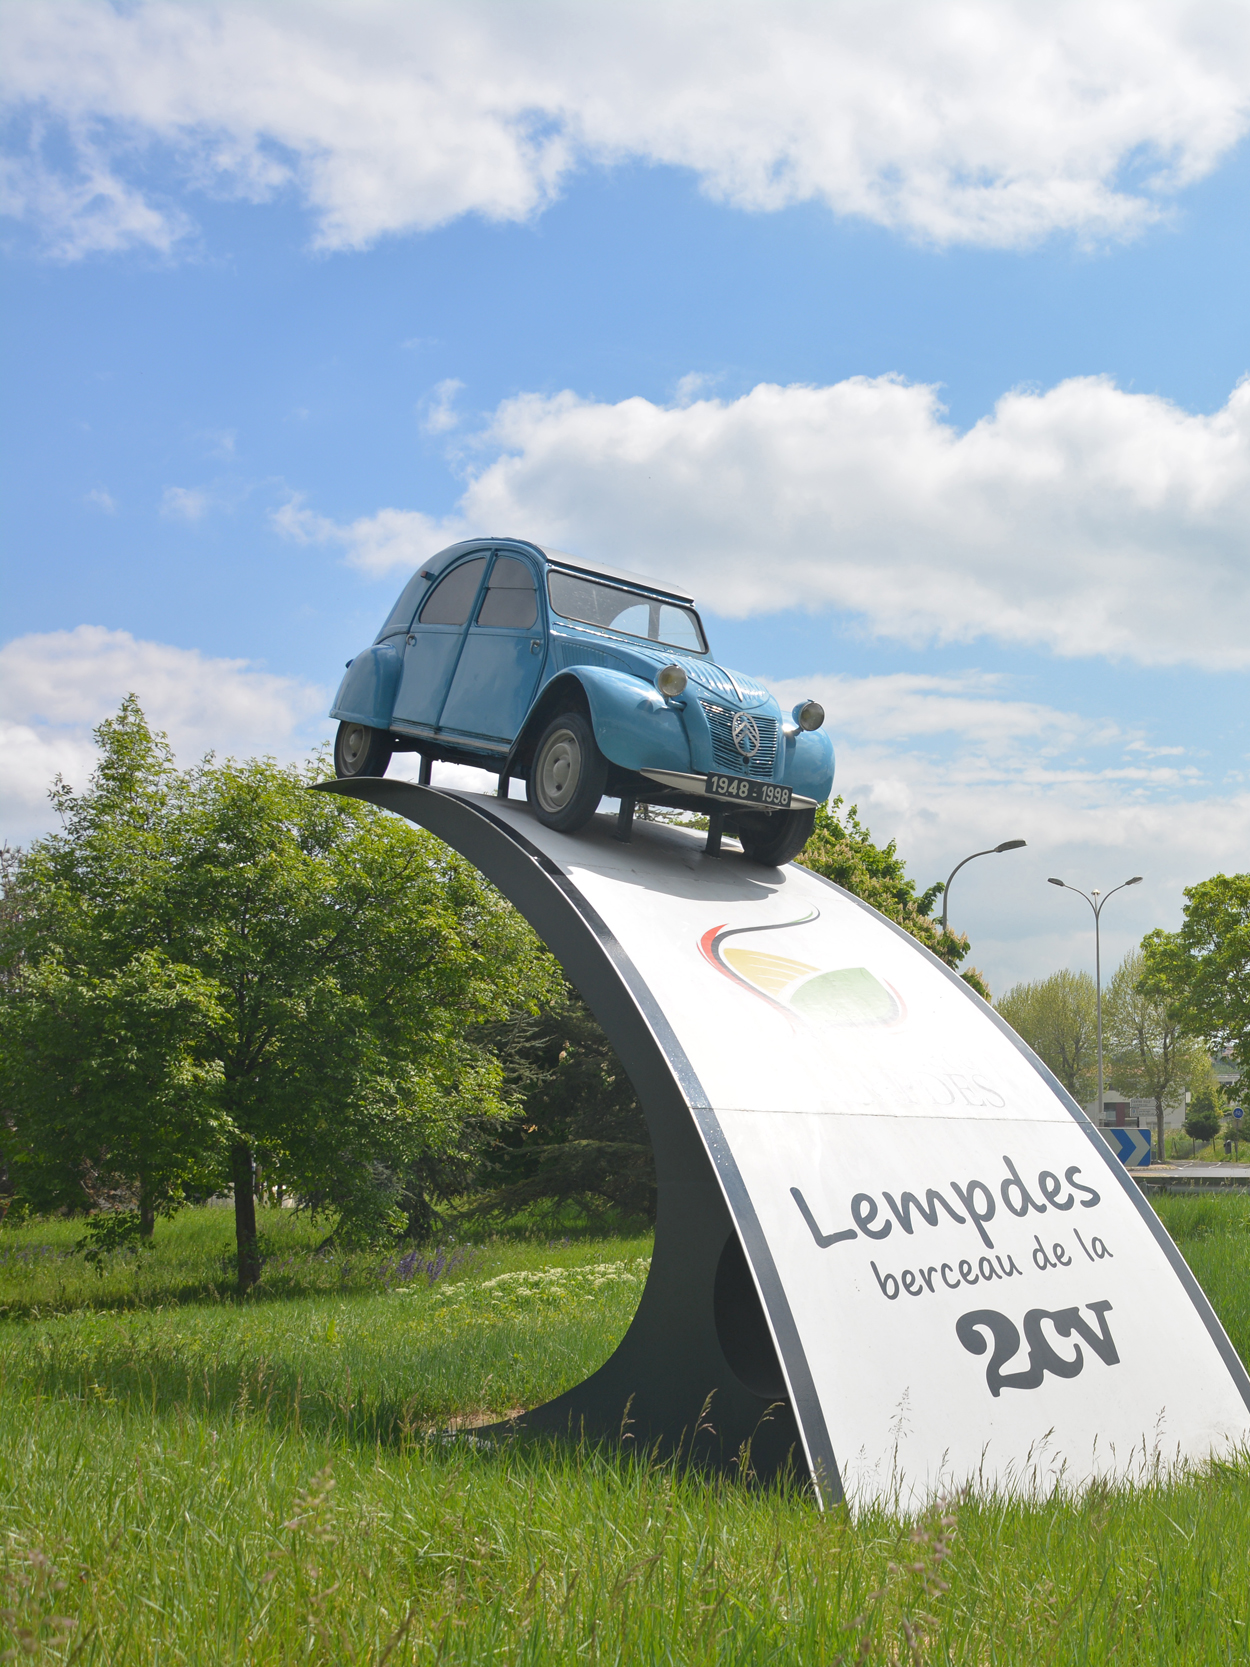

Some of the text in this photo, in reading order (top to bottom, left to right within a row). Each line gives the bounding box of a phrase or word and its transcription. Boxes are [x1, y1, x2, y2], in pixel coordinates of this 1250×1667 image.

[711, 776, 749, 797] 1948
[762, 785, 789, 805] 1998
[789, 1155, 1101, 1250] Lempdes
[869, 1227, 1114, 1300] berceau de la
[955, 1299, 1121, 1398] 2CV
